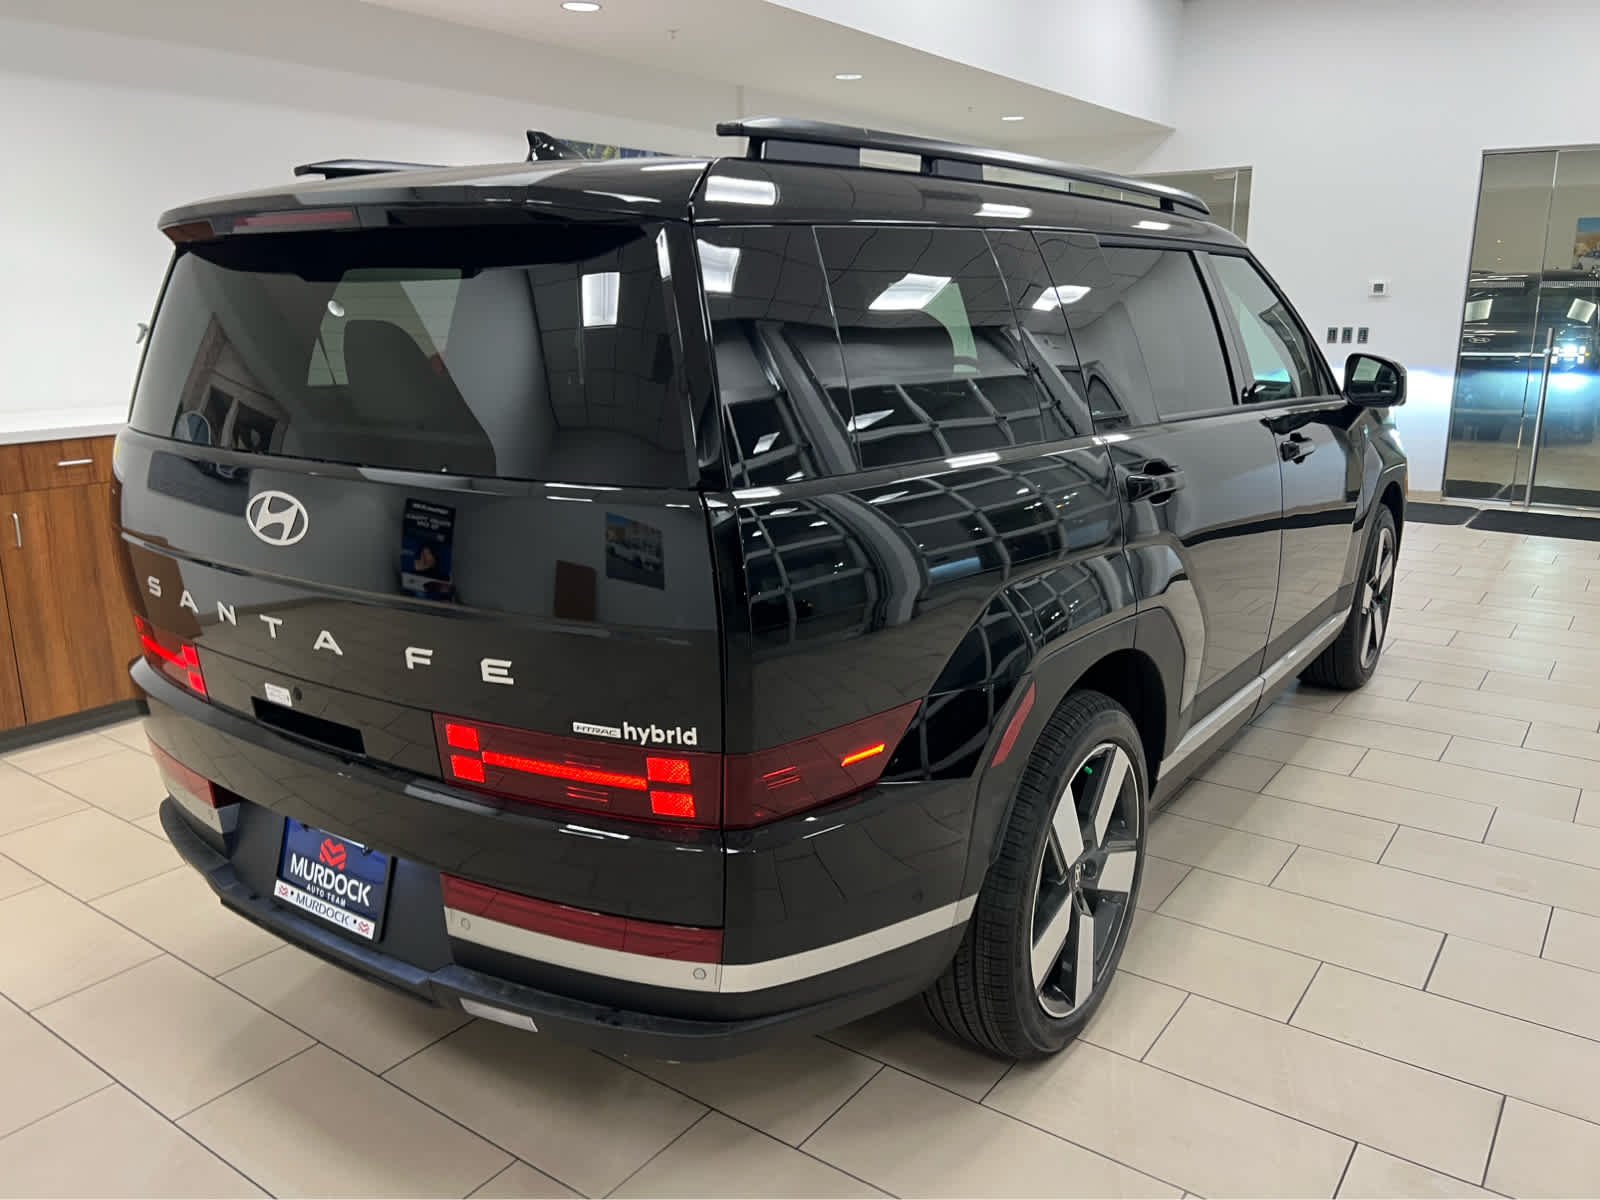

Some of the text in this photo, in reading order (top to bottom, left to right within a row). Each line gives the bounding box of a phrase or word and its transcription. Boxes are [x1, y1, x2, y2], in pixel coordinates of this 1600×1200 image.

[147, 576, 514, 685] SANTA FE
[623, 721, 697, 746] hybrid
[290, 853, 371, 907] MURDOCK
[306, 883, 347, 907] AUTO TEAM
[295, 893, 350, 926] MURDOCK
